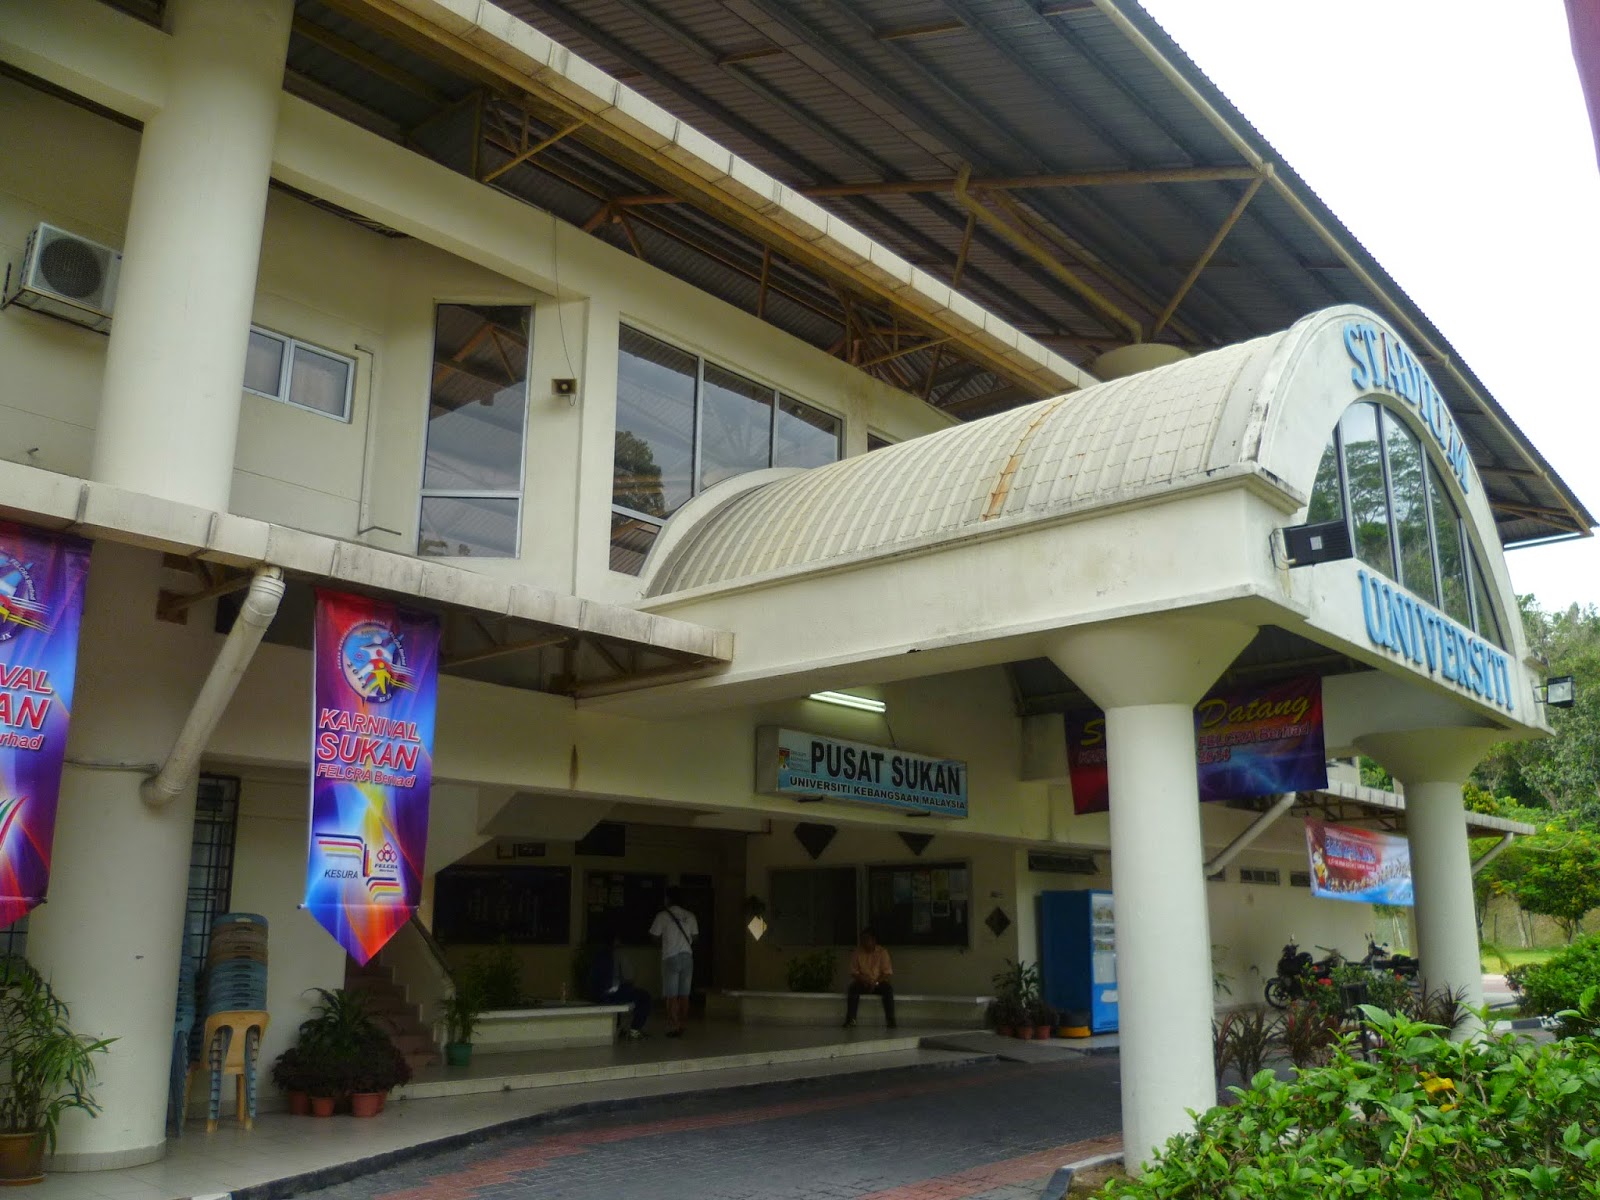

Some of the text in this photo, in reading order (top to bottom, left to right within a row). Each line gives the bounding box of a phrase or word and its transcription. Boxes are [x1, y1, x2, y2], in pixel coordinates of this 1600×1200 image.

[1344, 324, 1469, 494] STADIUM
[1357, 569, 1514, 711] UNIVERSITI
[319, 708, 420, 742] KARNIVAL
[1198, 695, 1310, 728] Datang
[317, 732, 419, 771] SUKAN
[1198, 721, 1311, 748] FELCRA Berhad
[317, 763, 416, 788] FELCRA Berhad
[811, 740, 884, 784] PUSAT
[891, 755, 961, 796] SUKAN
[790, 776, 966, 810] UNIVERSITI KEBANGSAAN MALAYSIA
[324, 869, 359, 879] KESURA
